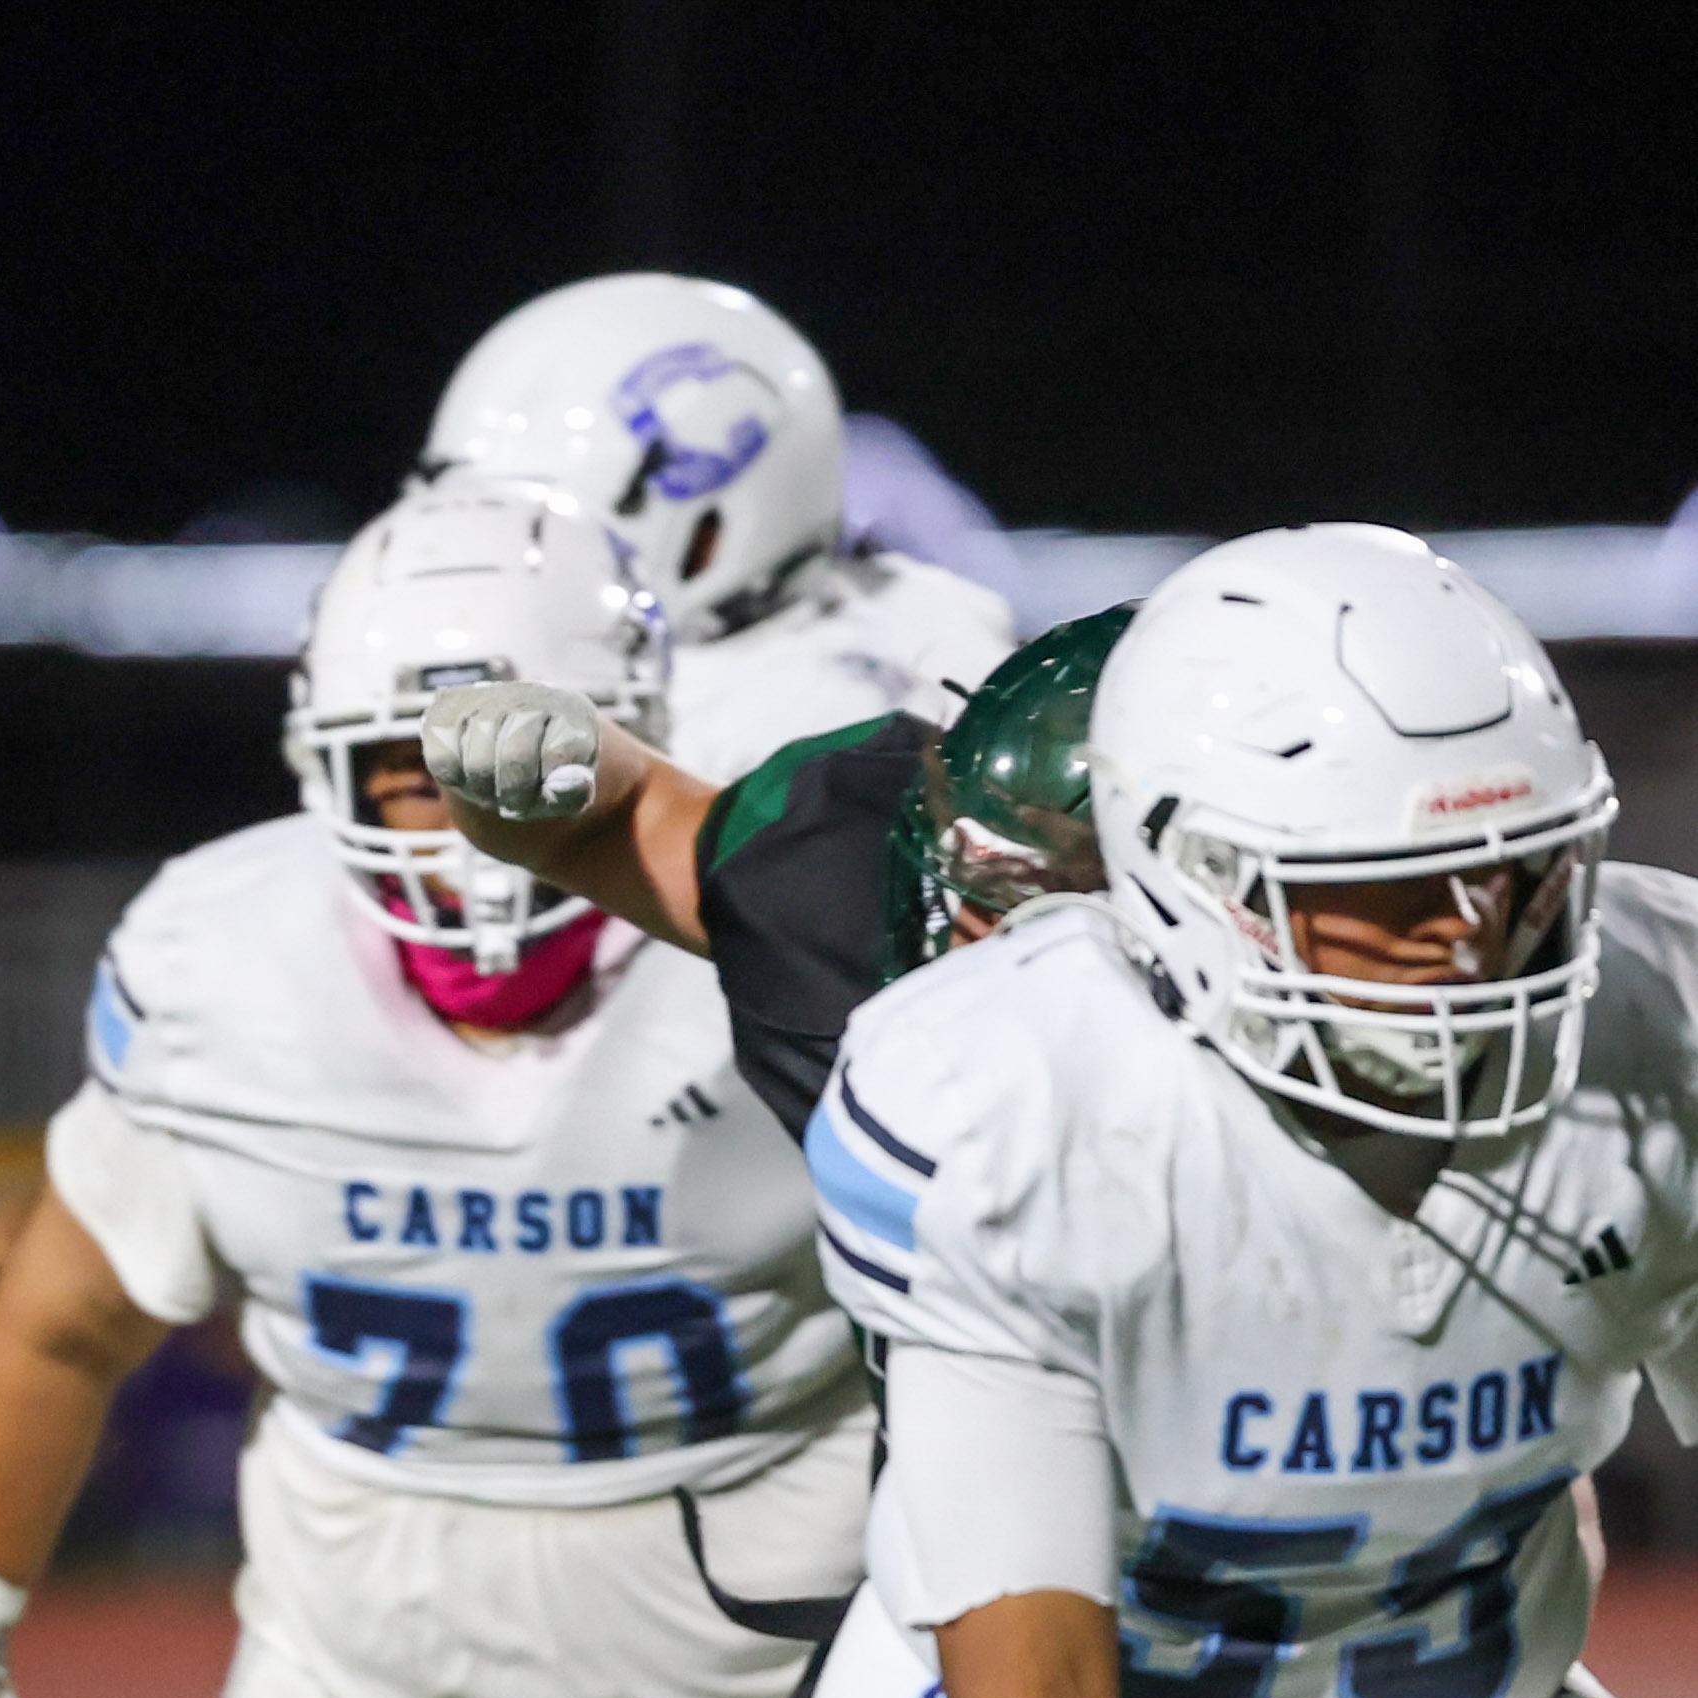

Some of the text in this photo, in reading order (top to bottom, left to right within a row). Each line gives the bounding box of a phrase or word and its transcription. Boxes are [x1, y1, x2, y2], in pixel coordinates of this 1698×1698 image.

[341, 1179, 665, 1253] CARSON
[301, 1268, 750, 1463] 70
[1220, 1349, 1564, 1474] CARSON
